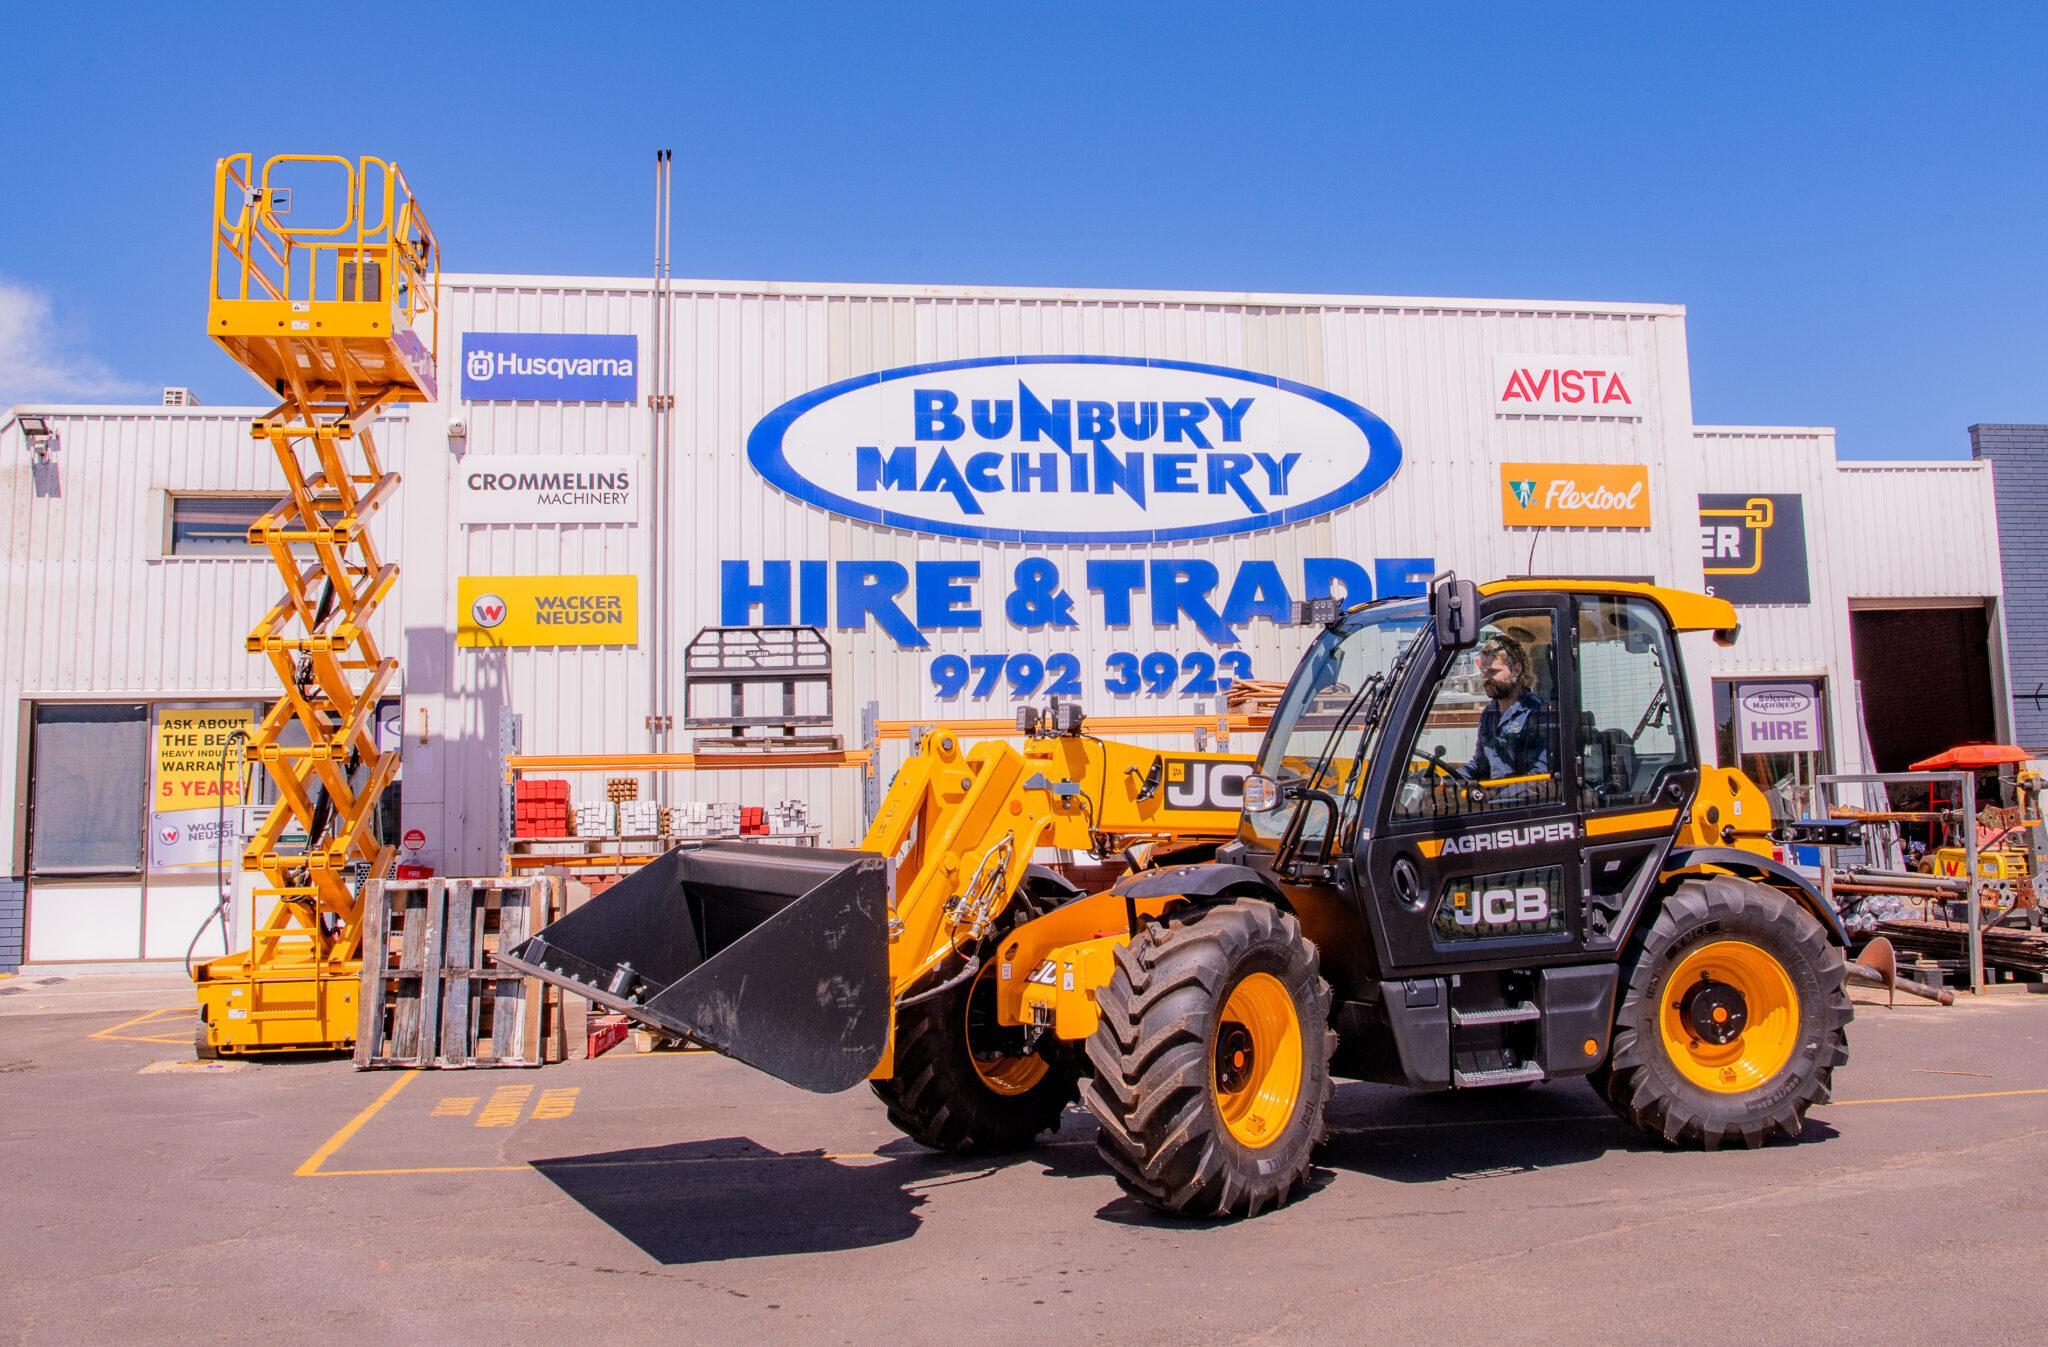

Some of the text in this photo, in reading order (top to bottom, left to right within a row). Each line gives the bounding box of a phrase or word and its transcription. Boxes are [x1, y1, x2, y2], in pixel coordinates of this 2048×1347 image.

[498, 353, 633, 379] Husqvarna
[1501, 368, 1632, 405] AVISTA
[914, 378, 1256, 457] BUNBURY
[467, 472, 629, 491] CROMMELINS
[856, 437, 1303, 515] MACHINERY
[537, 492, 629, 506] MACHINERY
[1545, 479, 1643, 511] Flextool
[1699, 526, 1741, 557] ER
[535, 596, 622, 609] WACKER
[721, 559, 982, 648] HIRE
[1006, 557, 1079, 628] &
[536, 611, 622, 625] NEUSON
[930, 651, 1255, 697] 9792 3923
[1752, 702, 1802, 711] MACHINERY
[163, 718, 248, 730] ASK ABOUT
[1751, 720, 1809, 741] HIRE
[163, 734, 198, 747] THE
[161, 750, 195, 758] HEAVY
[162, 781, 173, 797] 5
[1168, 763, 1253, 807] JC
[188, 829, 235, 841] NEUSO
[1440, 822, 1576, 857] AGRISUPER
[1454, 886, 1549, 926] JCB
